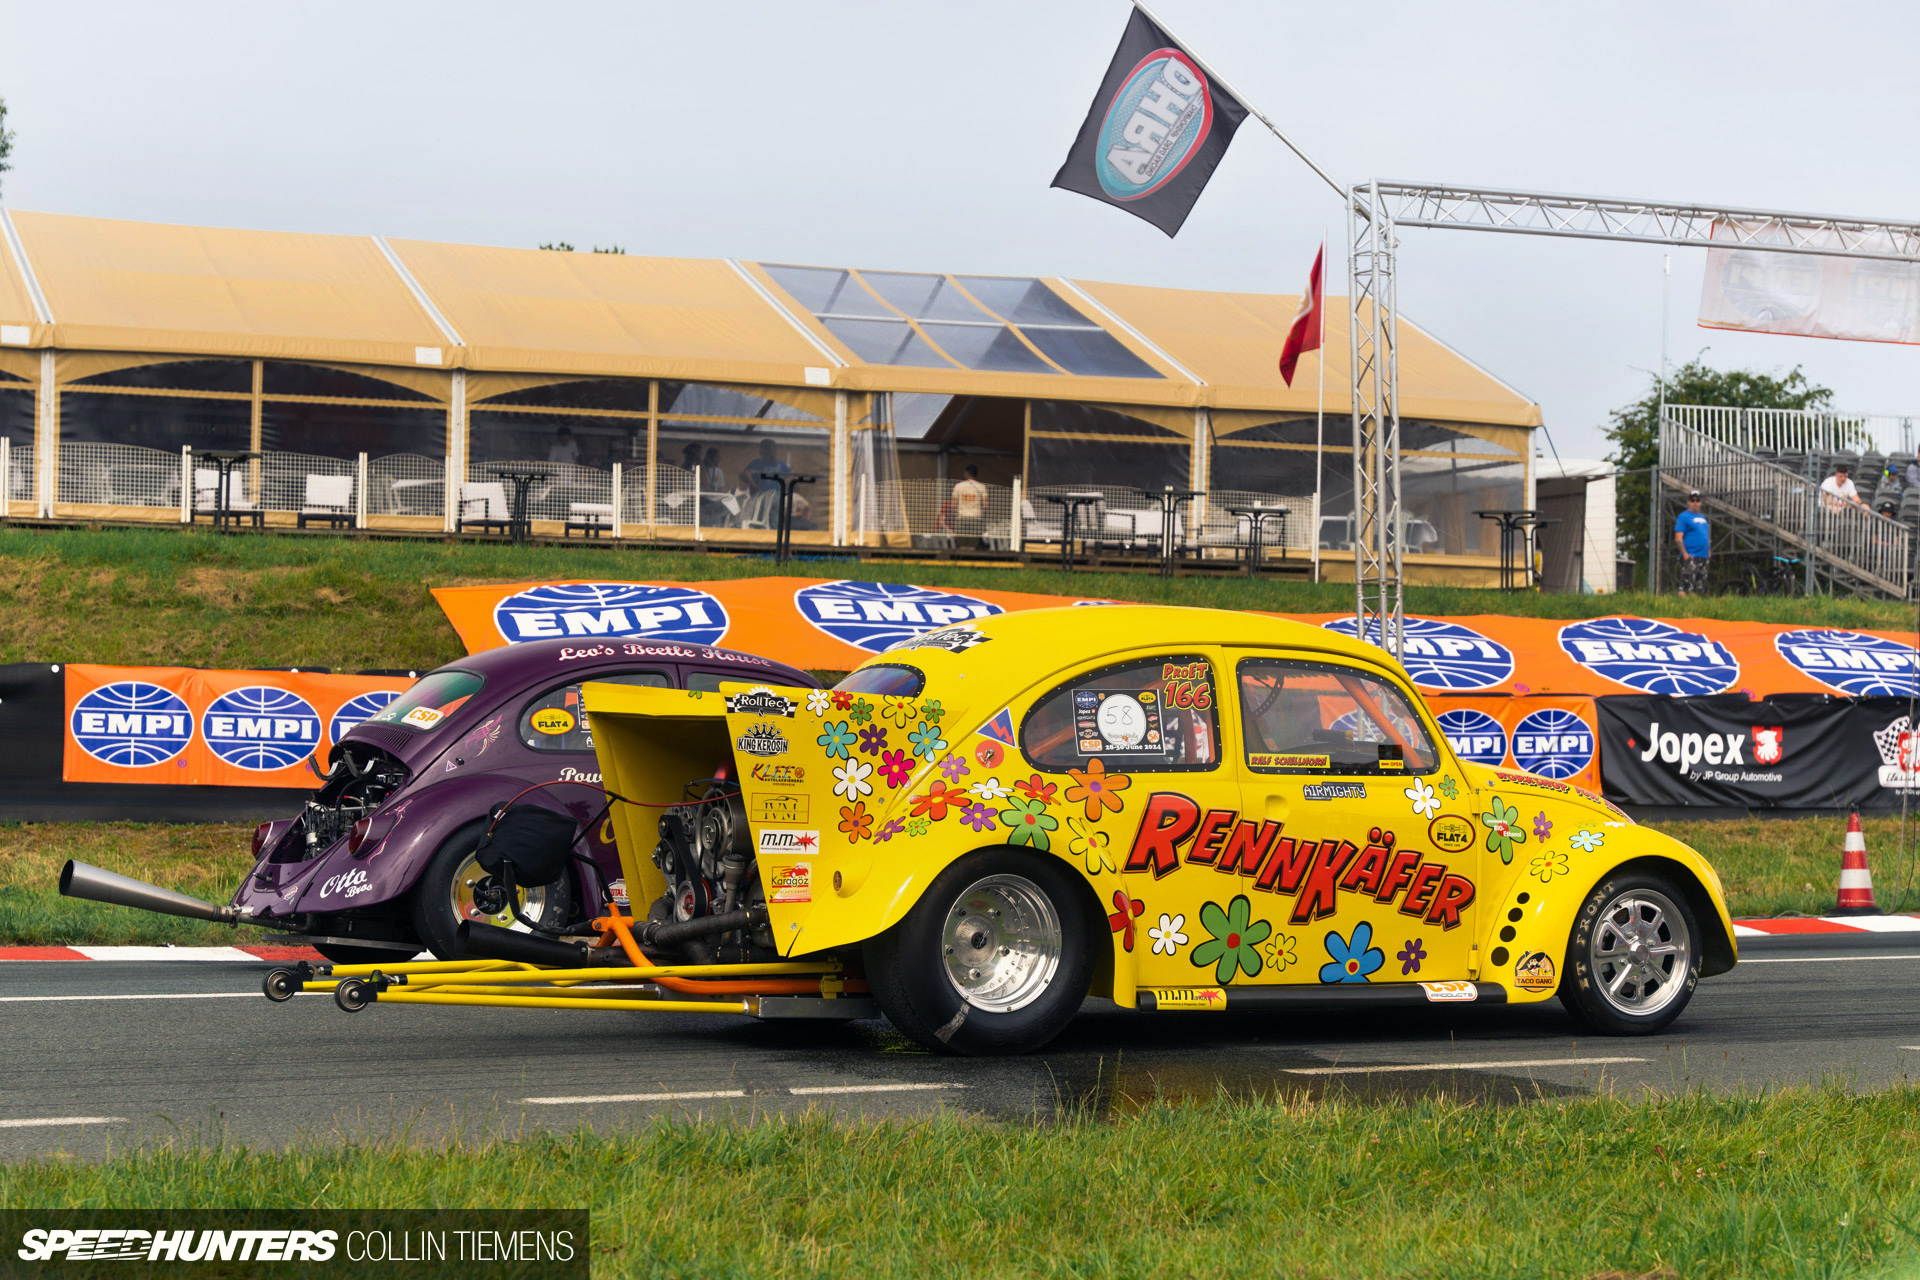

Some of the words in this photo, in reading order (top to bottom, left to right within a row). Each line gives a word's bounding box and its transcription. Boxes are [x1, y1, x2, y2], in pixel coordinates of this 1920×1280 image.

[509, 601, 713, 637] EMPI
[809, 598, 992, 625] EMPI
[559, 644, 615, 661] Leo's
[623, 643, 696, 658] Beetle
[702, 647, 772, 668] House
[1572, 641, 1726, 667] EMPI
[1164, 681, 1212, 711] 166
[80, 712, 185, 736] EMPI
[409, 709, 439, 722] CSP
[1105, 705, 1133, 725] 58
[211, 716, 314, 740] EMPI
[738, 738, 756, 751] KING
[757, 739, 789, 752] KEROSIN
[1449, 736, 1502, 754] MPI
[1517, 735, 1589, 754] EMPI
[1641, 722, 1746, 775] Jopex
[1251, 756, 1272, 766] RALF
[1274, 756, 1328, 767] SCHELLHORN
[1690, 771, 1702, 782] by
[1702, 771, 1714, 780] JP
[1715, 772, 1740, 783] Group
[1740, 772, 1783, 782] Automotive
[1303, 784, 1367, 799] AIRMIGHTY
[320, 867, 368, 898] Otto
[345, 883, 373, 898] Bros
[772, 875, 809, 888] Karagöz
[1576, 881, 1615, 946] FRONT
[1576, 962, 1590, 991] ET
